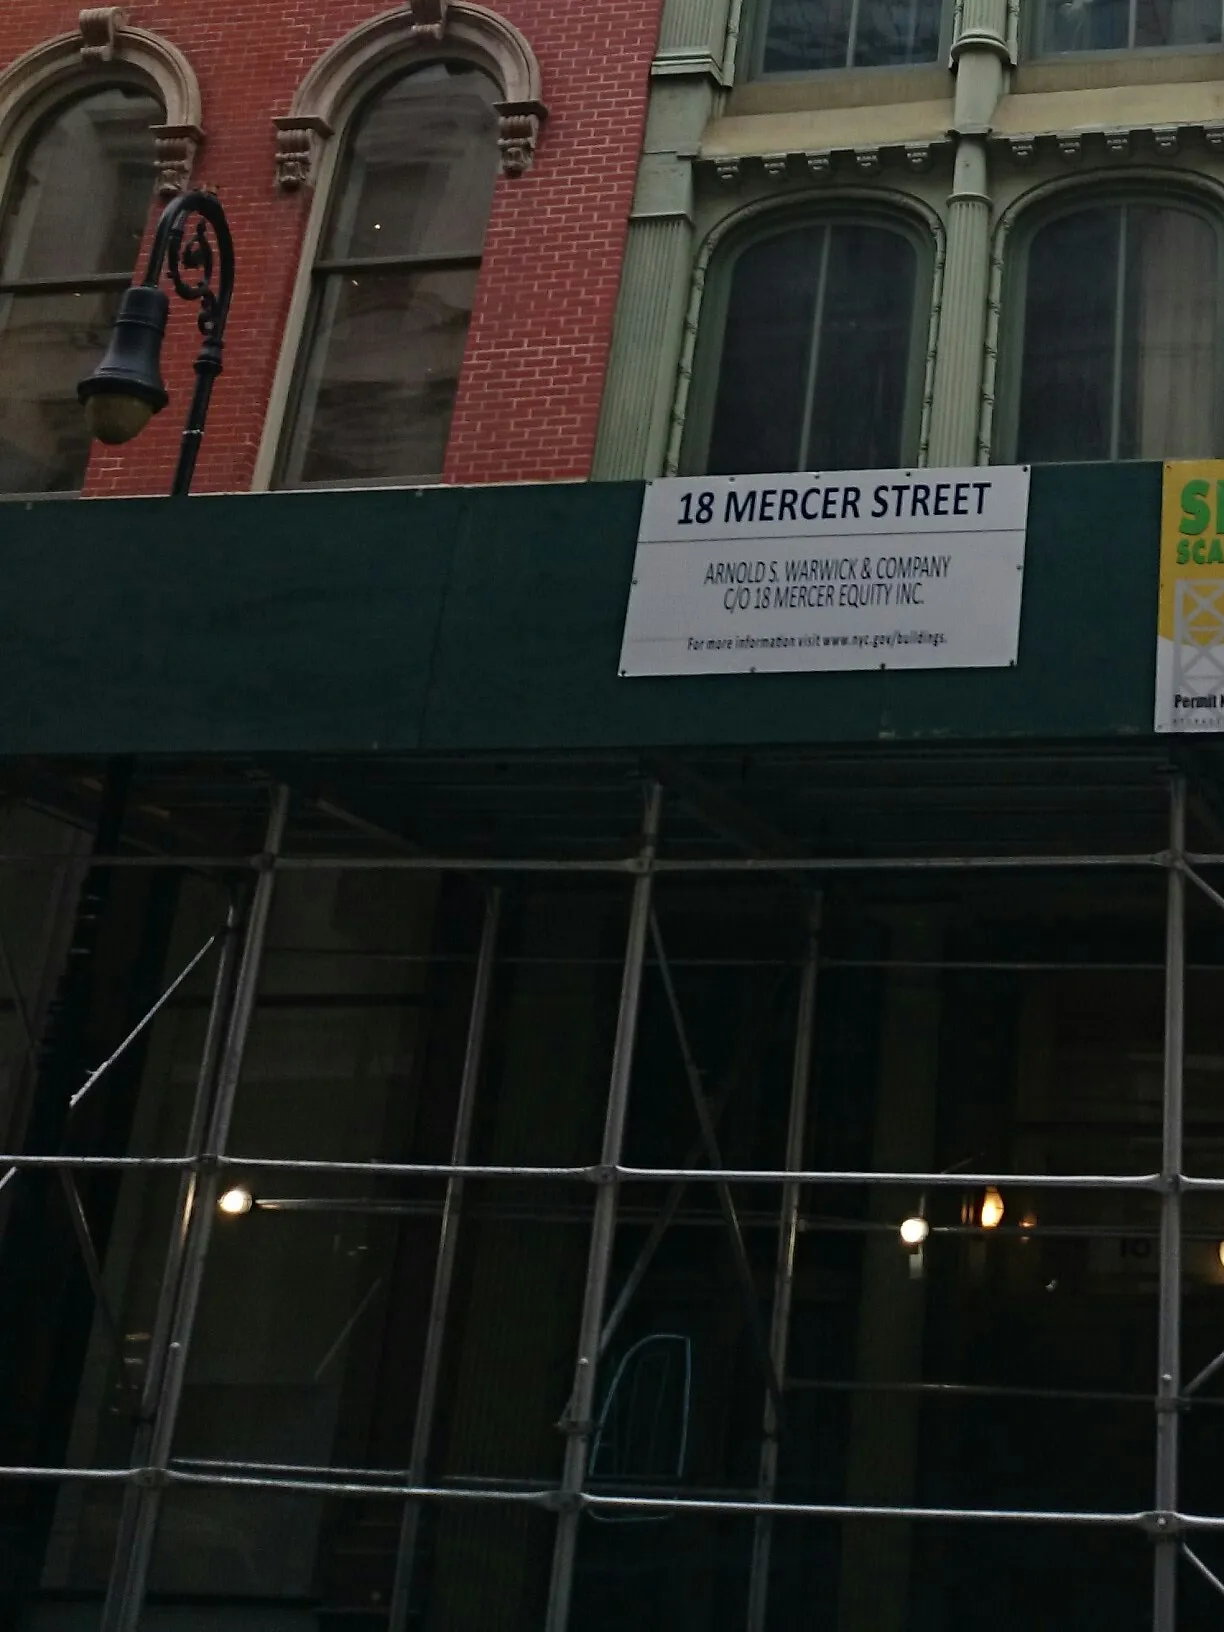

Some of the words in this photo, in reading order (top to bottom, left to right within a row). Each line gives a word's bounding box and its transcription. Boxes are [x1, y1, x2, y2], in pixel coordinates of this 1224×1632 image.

[677, 491, 714, 525] 18
[724, 486, 861, 523] MERCER
[871, 482, 992, 518] STREET
[704, 560, 766, 585] ARNOLD
[785, 558, 858, 582] WARWICK
[861, 557, 871, 580] &
[876, 555, 952, 579] COMPANY
[723, 585, 751, 614] C/O
[754, 586, 771, 609] 18
[774, 584, 835, 608] MERCER
[839, 582, 893, 608] EQUITY
[896, 582, 924, 605] INC.
[687, 636, 704, 651] For
[706, 638, 733, 650] more
[735, 633, 796, 649] information
[797, 632, 820, 647] visit
[1173, 693, 1218, 709] Permit
